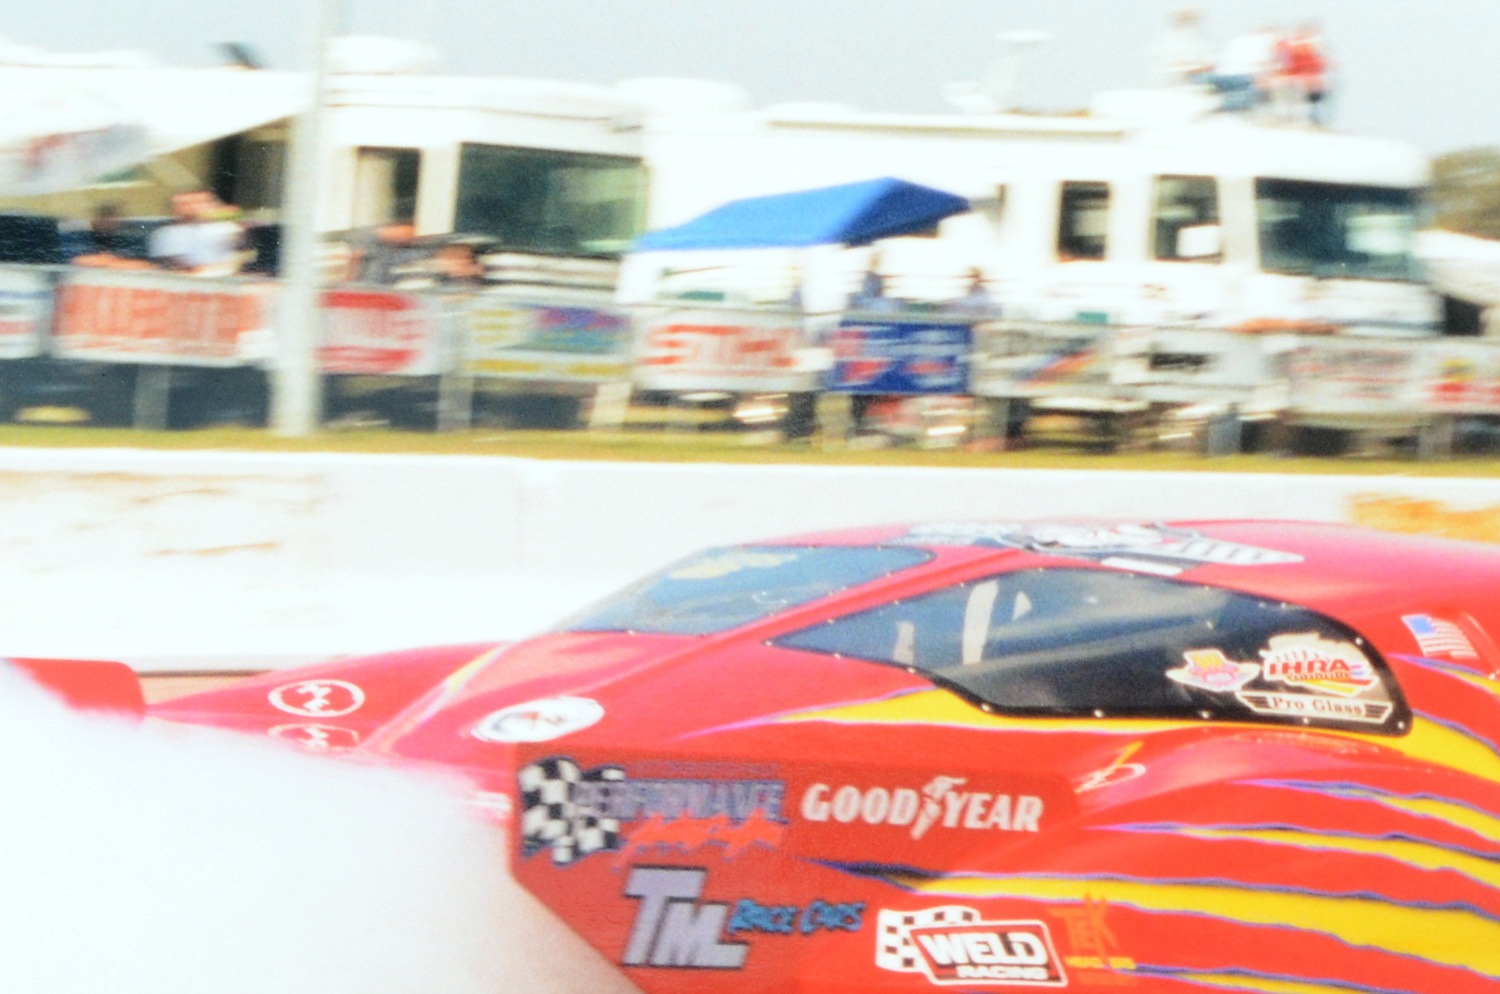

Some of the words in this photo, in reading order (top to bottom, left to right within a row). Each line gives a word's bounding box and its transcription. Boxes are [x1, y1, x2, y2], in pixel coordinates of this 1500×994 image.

[1269, 658, 1350, 677] IHRA
[1272, 696, 1304, 711] Pro
[1311, 698, 1364, 717] Glass
[917, 931, 1049, 966] WELD
[956, 965, 1050, 981] RACING
